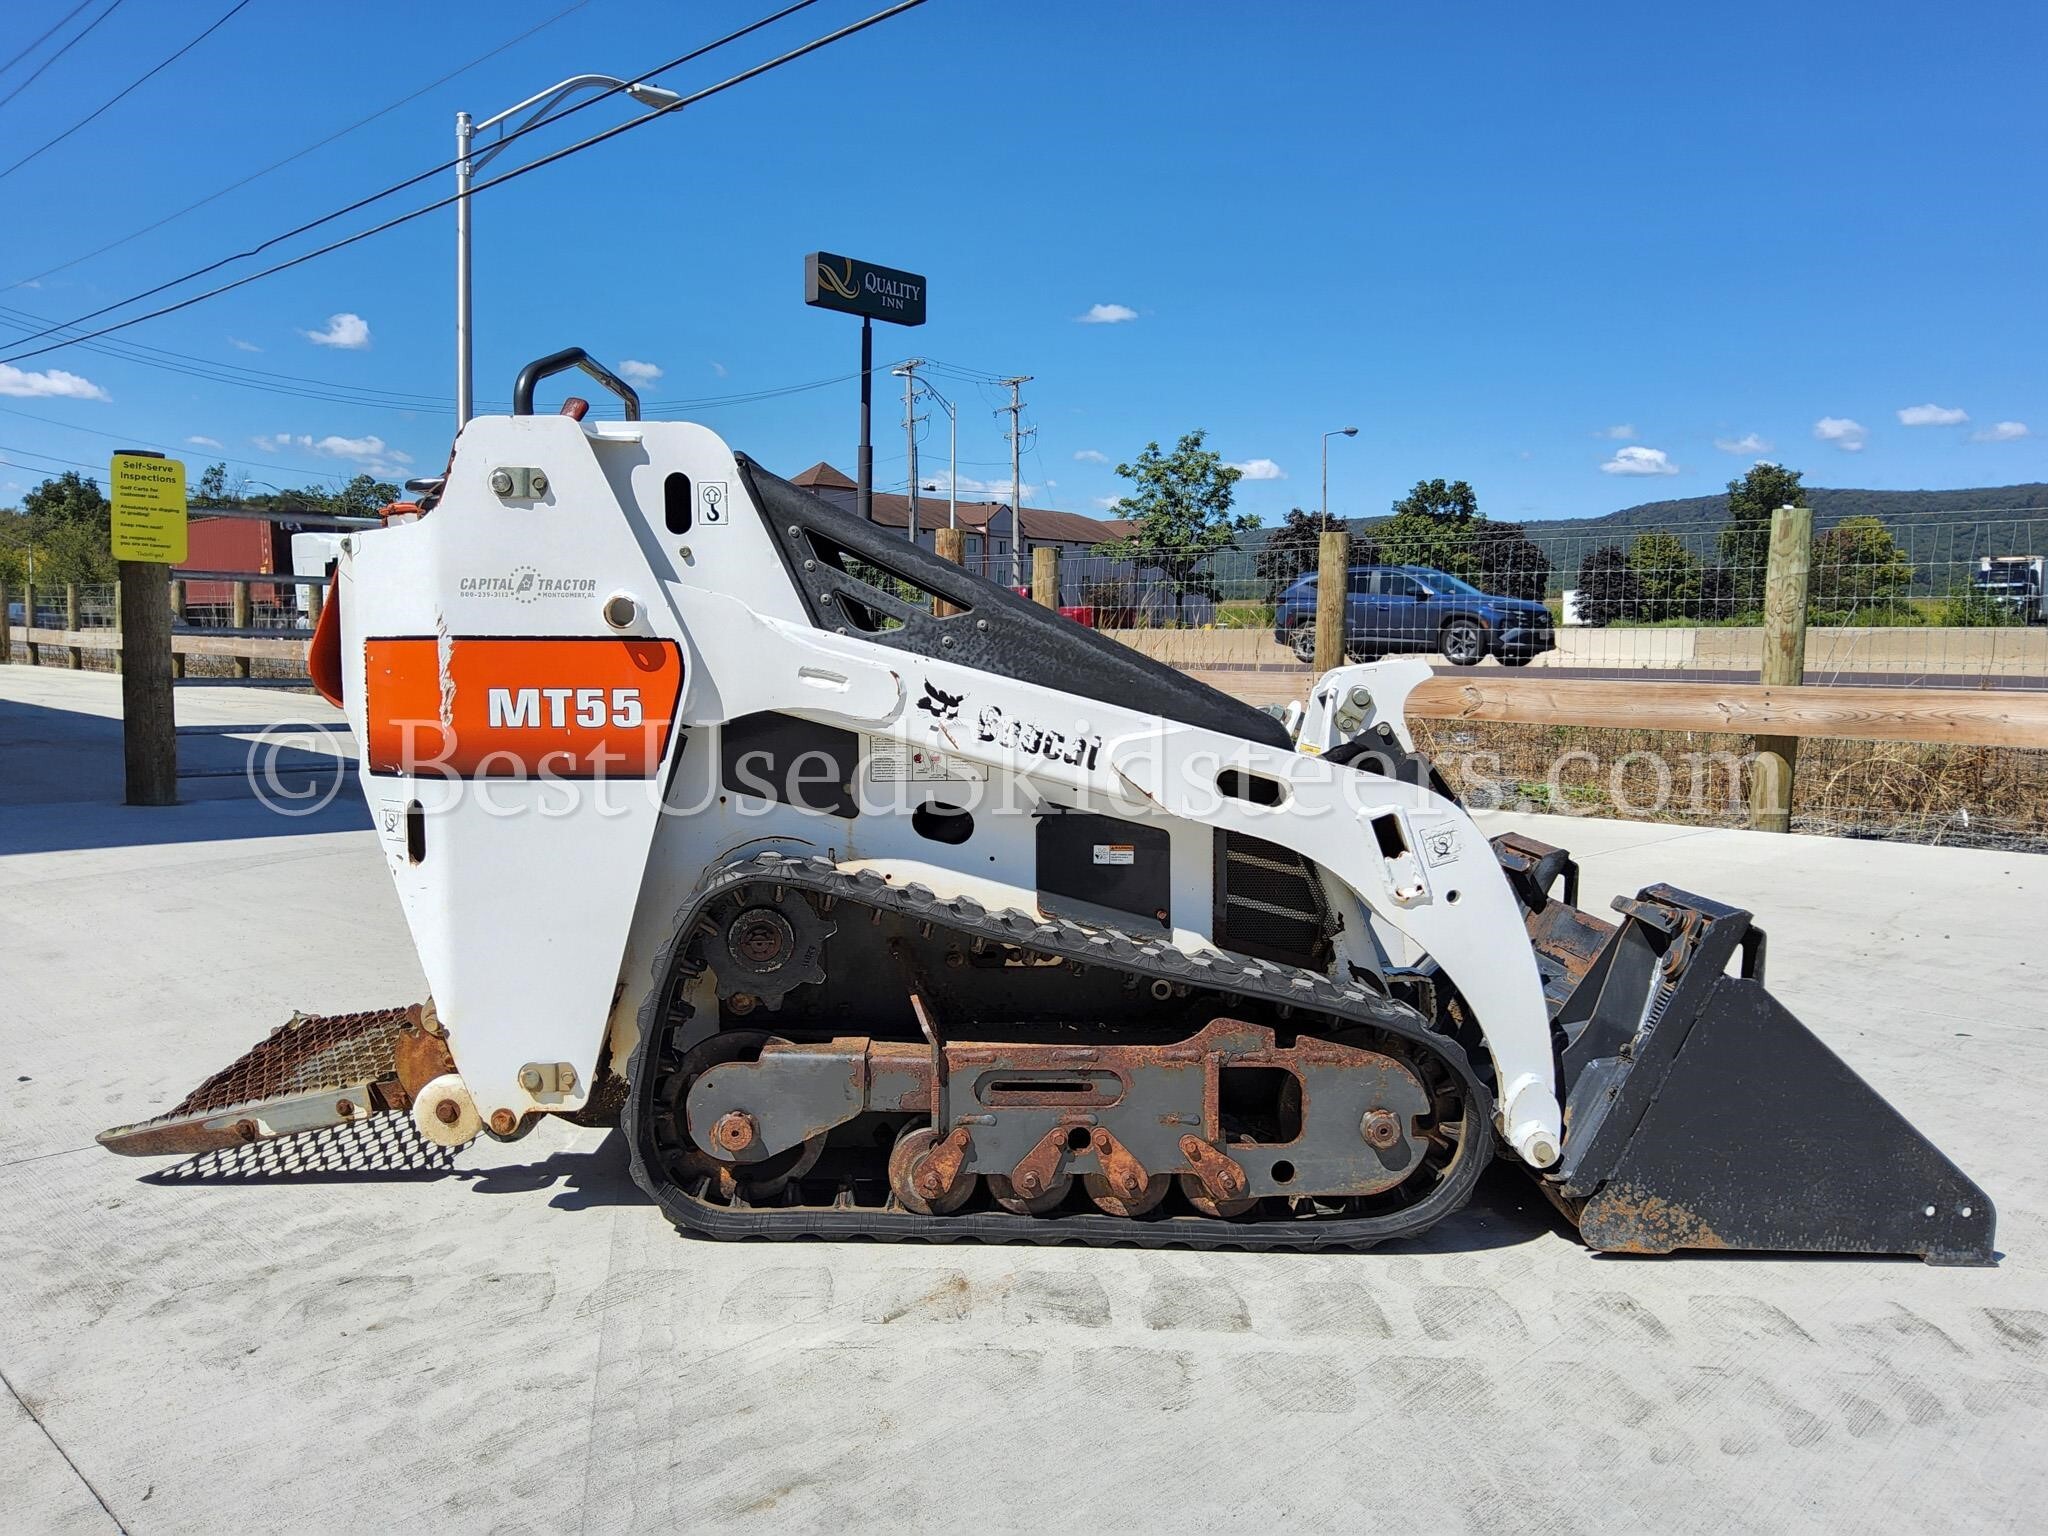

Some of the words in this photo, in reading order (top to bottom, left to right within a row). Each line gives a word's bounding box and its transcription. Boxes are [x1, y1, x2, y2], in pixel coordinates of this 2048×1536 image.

[865, 272, 920, 301] QUALITY
[882, 296, 904, 310] INN
[123, 461, 174, 473] Self-Serve
[120, 472, 177, 484] Inspections
[460, 578, 515, 590] CAPITAL
[538, 579, 596, 591] TRACTOR
[488, 687, 643, 729] MT55
